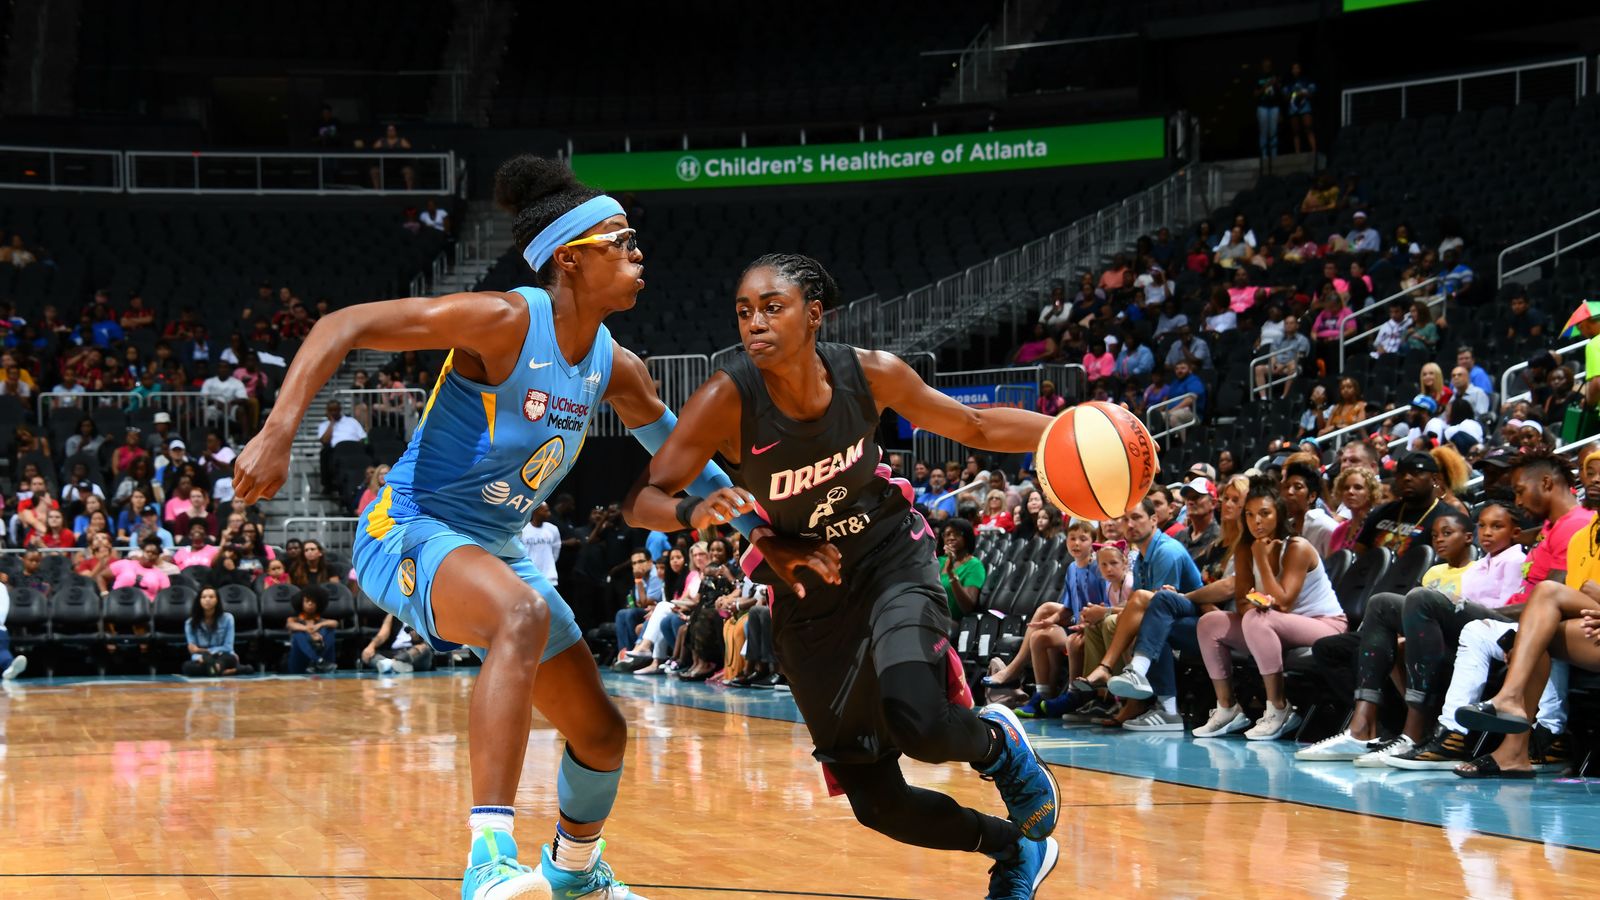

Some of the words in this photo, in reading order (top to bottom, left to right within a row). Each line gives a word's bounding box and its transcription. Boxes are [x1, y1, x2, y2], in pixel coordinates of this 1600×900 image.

[704, 155, 814, 177] Children's
[820, 150, 935, 172] Healthcare
[941, 143, 963, 164] of
[969, 139, 1047, 162] Atlanta
[547, 412, 584, 432] Medicine
[769, 437, 865, 500] DREAM
[825, 512, 871, 541] AT&T
